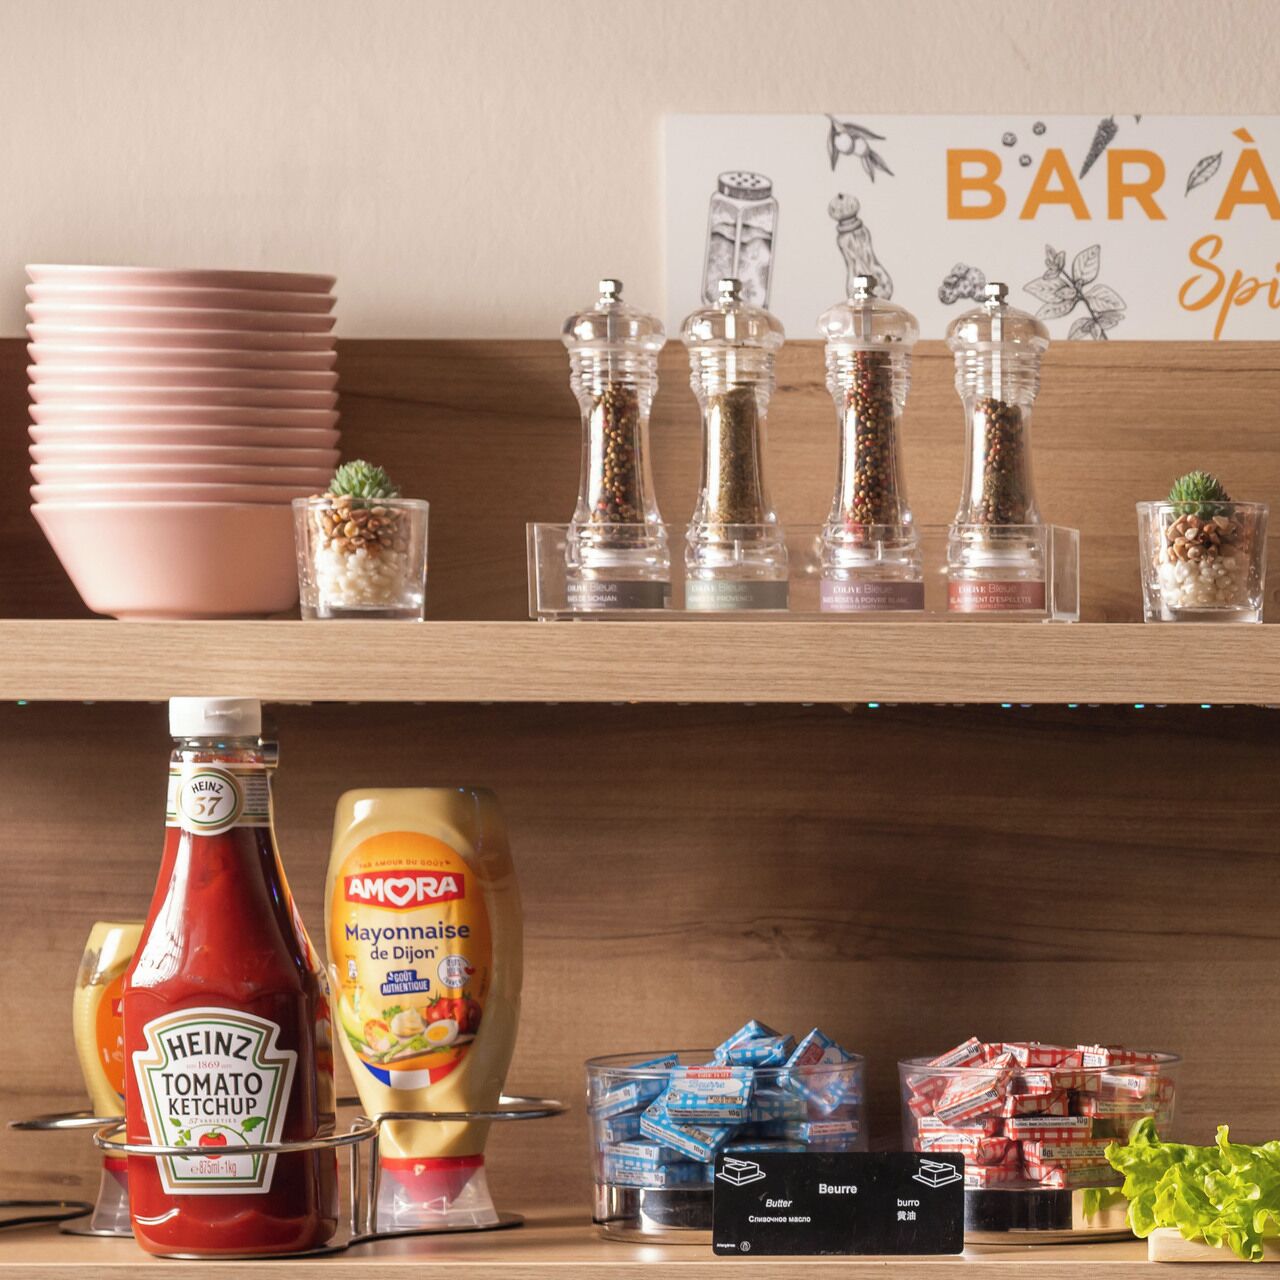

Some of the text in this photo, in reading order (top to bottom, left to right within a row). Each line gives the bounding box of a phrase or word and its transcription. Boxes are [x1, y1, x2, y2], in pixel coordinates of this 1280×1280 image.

[945, 147, 1168, 222] BAR
[191, 781, 224, 794] HEINZ
[192, 796, 224, 817] 57
[349, 876, 459, 906] AMORA
[345, 920, 471, 946] Mayonnaise
[370, 946, 389, 960] de
[393, 970, 413, 983] GOÛT
[382, 980, 429, 994] AUTHENTIQUE
[166, 1030, 253, 1062] HEINZ
[198, 1061, 221, 1069] 1869
[161, 1072, 263, 1096] TOMATO
[169, 1098, 257, 1116] KETCHUP
[1076, 1116, 1088, 1126] 10g
[818, 1183, 858, 1195] Beurre
[765, 1198, 793, 1208] Butter
[897, 1198, 920, 1207] burro
[748, 1215, 812, 1223] Сливочное масло
